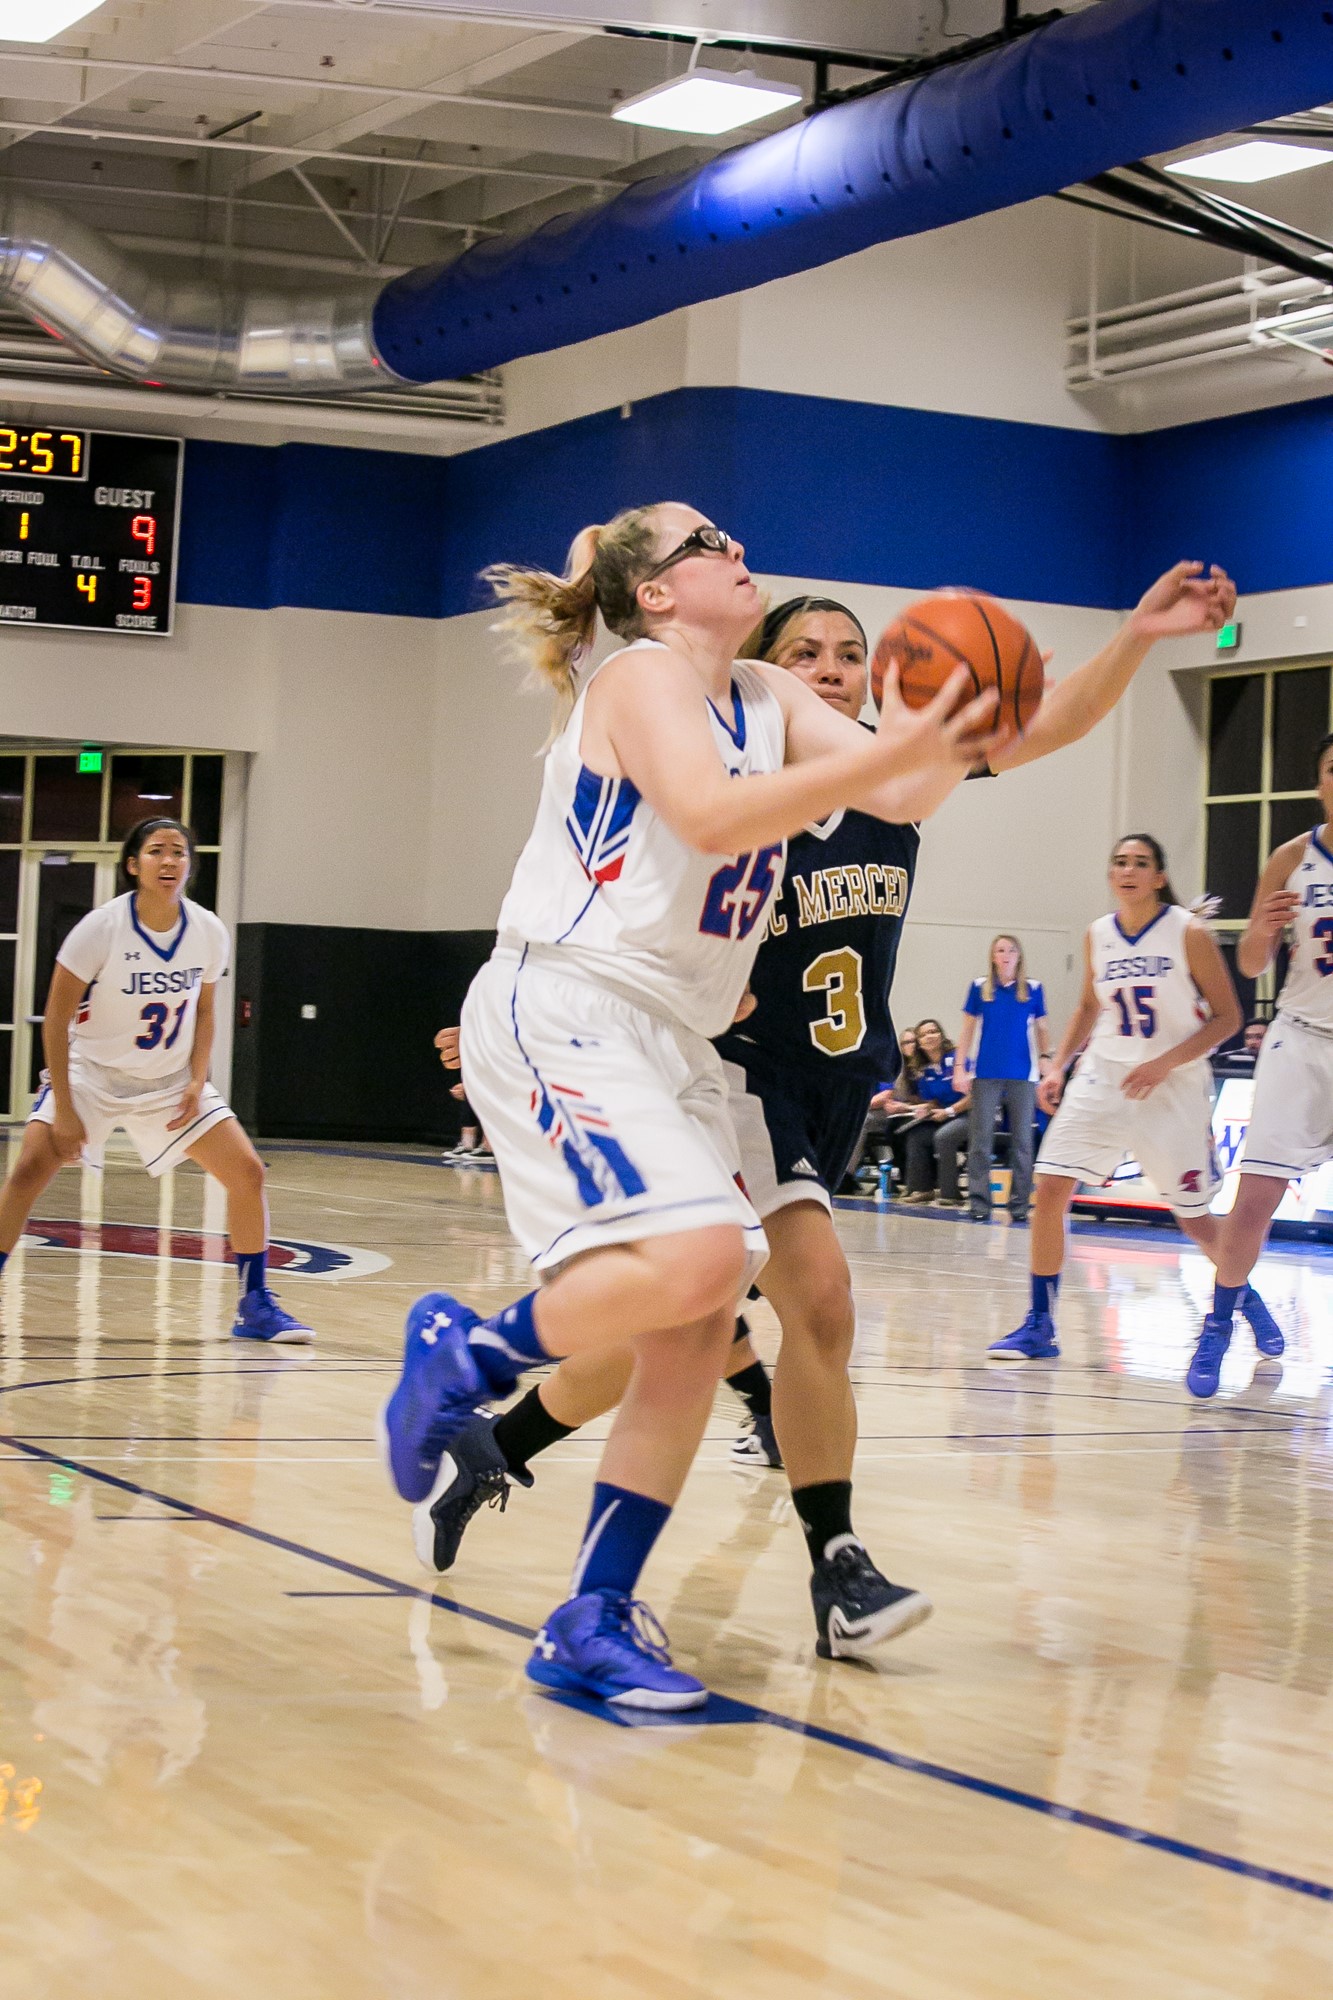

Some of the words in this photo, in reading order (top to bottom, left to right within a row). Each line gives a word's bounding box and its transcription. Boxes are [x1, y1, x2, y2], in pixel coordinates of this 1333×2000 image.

[0, 489, 44, 505] PERIOD
[94, 486, 155, 509] GUEST
[20, 512, 29, 540] 1
[131, 515, 156, 555] 9
[27, 551, 60, 567] FOUL
[118, 558, 160, 574] FOULS
[76, 573, 97, 603] 4
[132, 576, 152, 610] 3
[115, 613, 157, 629] SCORE
[792, 863, 908, 928] MERCED
[1098, 955, 1174, 983] JESSUP
[802, 945, 867, 1056] 3
[1109, 986, 1156, 1038] 15
[134, 999, 189, 1051] 31
